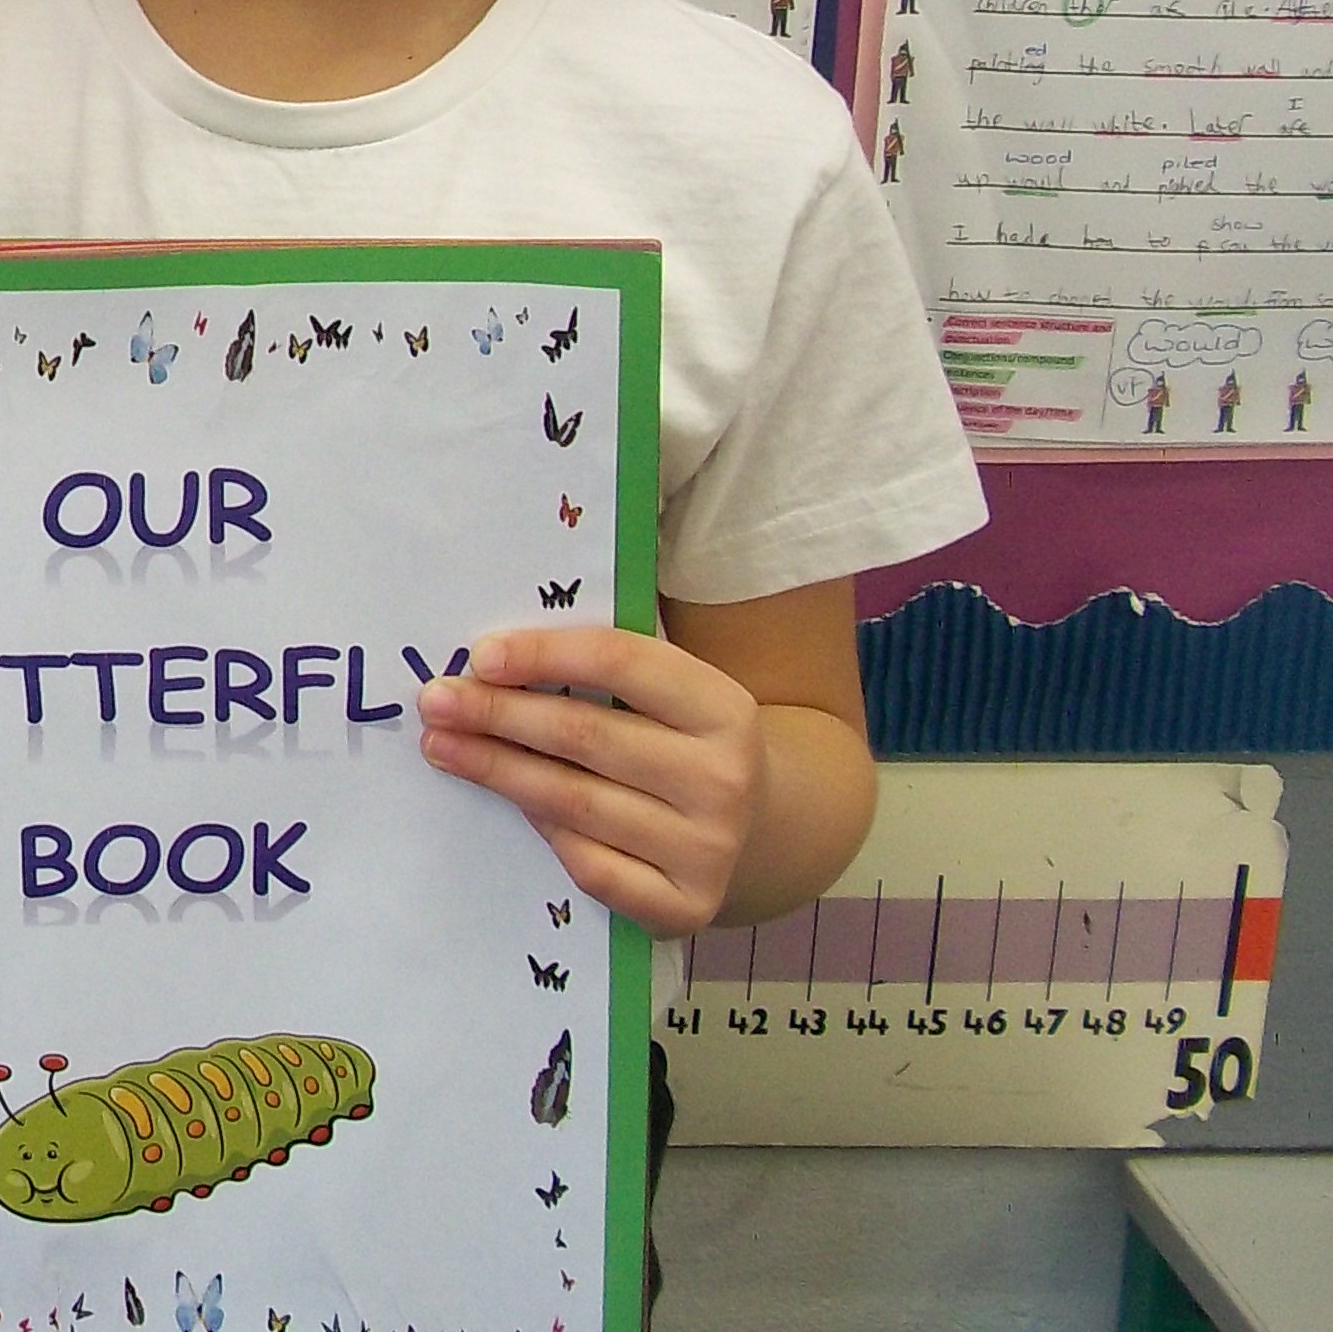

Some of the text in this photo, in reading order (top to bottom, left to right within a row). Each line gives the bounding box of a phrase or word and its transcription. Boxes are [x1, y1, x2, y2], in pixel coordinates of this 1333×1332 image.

[1025, 44, 1047, 56] ed
[1079, 52, 1114, 74] the
[967, 105, 1003, 128] the
[1189, 108, 1252, 136] Later
[1005, 149, 1073, 165] wood
[952, 224, 968, 242] I
[1211, 216, 1264, 231] show
[1040, 321, 1089, 333] structure
[1144, 335, 1243, 354] would
[41, 468, 273, 550] OUR
[21, 821, 313, 898] BOOK
[667, 1008, 1187, 1035] 41 42 43 44 45 46 47 48 49
[1166, 1037, 1253, 1111] 50
